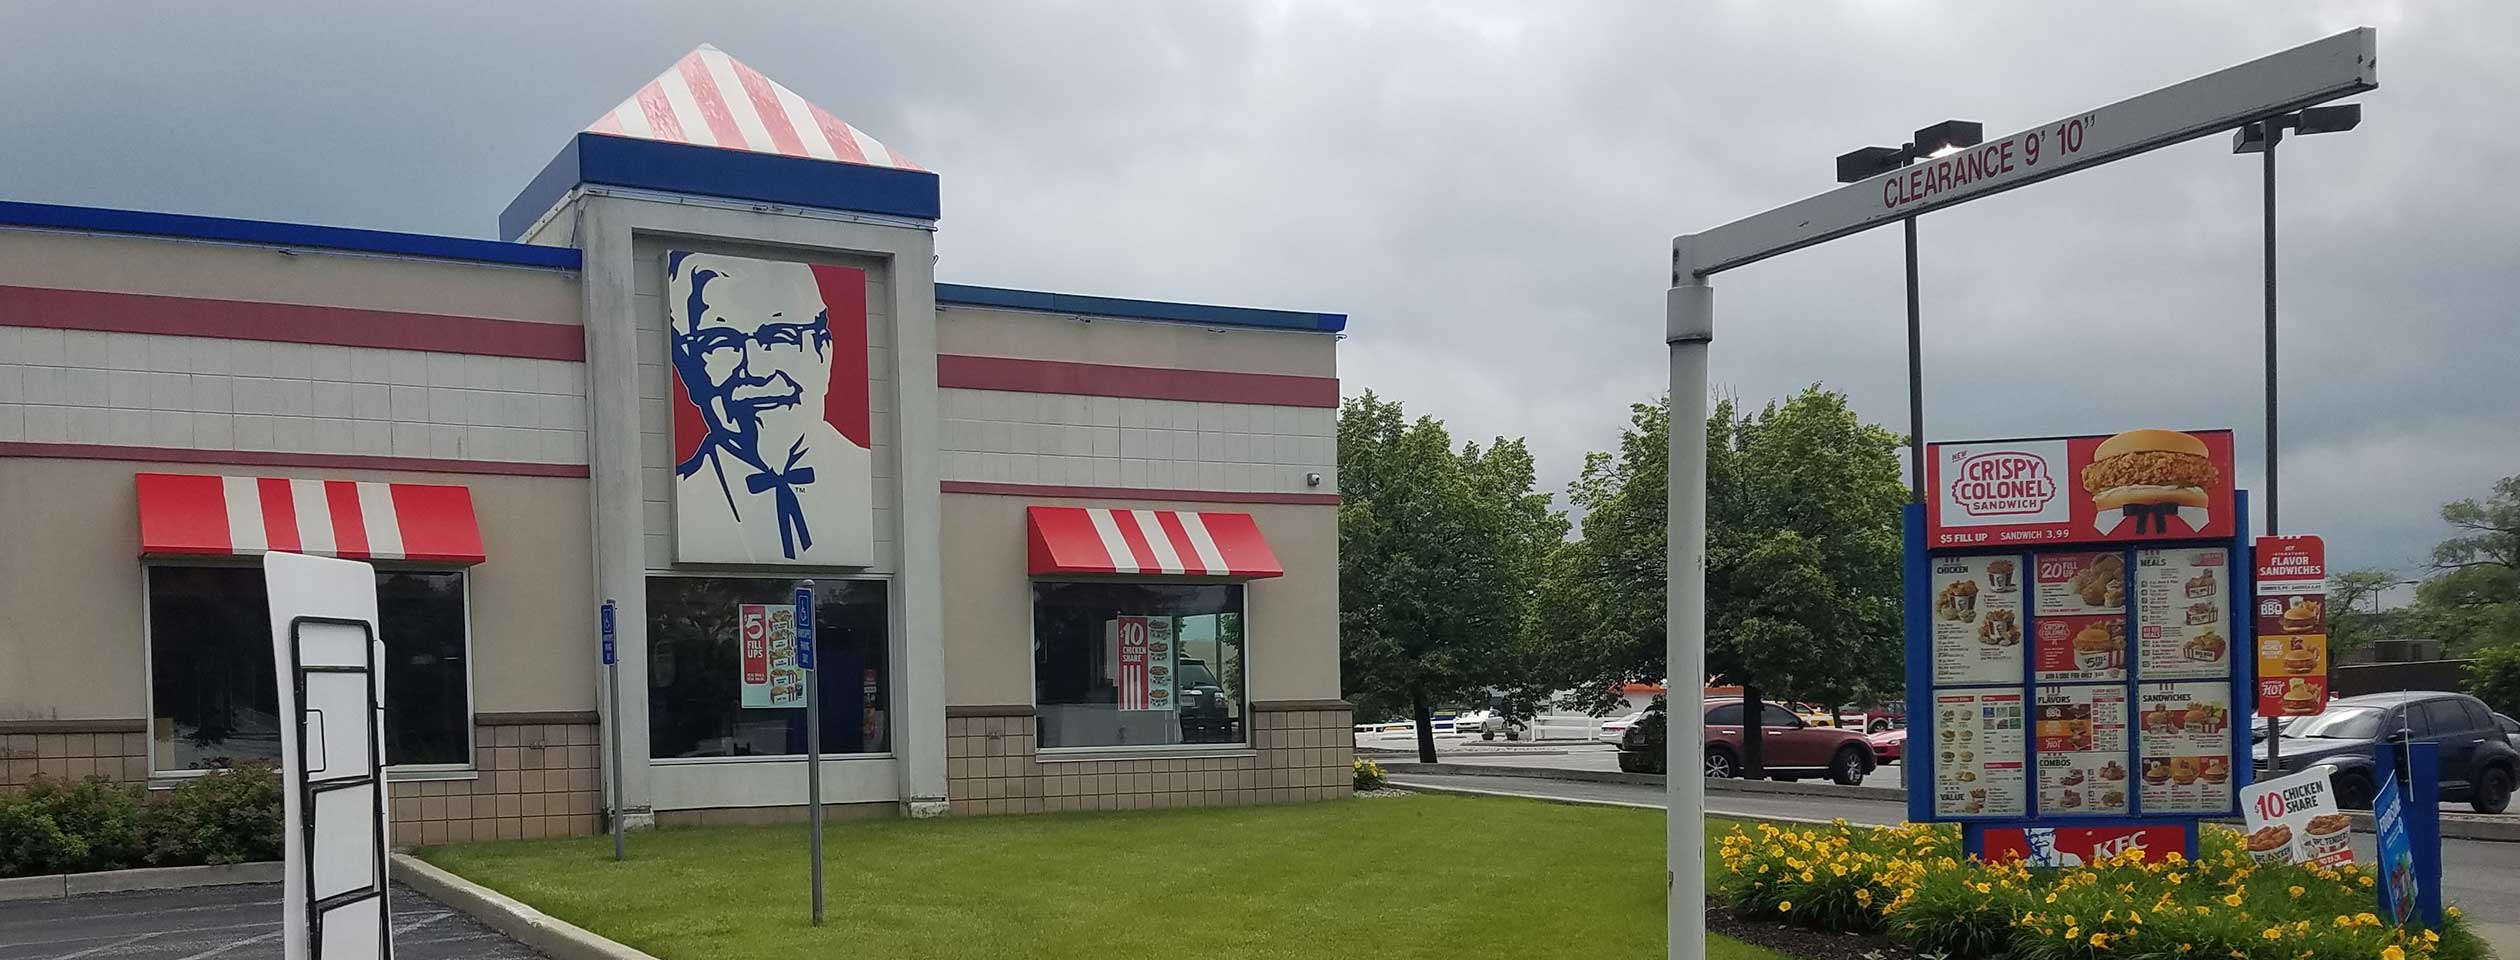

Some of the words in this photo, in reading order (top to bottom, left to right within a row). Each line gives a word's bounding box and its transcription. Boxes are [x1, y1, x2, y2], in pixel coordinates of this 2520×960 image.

[1884, 140, 2014, 208] CLEARANCE
[2025, 130, 2046, 166] 9'
[1969, 458, 2040, 481] CRISPY
[1961, 480, 2047, 500] COLONEL
[1973, 499, 2037, 510] SANDWICH
[1940, 533, 1953, 544] $5
[1954, 533, 1973, 543] FILL
[1975, 532, 1988, 541] UP
[2000, 530, 2042, 541] SANDWICH
[2047, 529, 2070, 539] 3.99
[2271, 556, 2309, 566] FLAVOR
[2063, 570, 2074, 578] UP
[2260, 565, 2321, 576] SANDWICHES
[2261, 602, 2283, 616] BBQ
[747, 640, 763, 650] FILL
[747, 649, 763, 659] UPS
[2262, 683, 2284, 696] HOT
[2038, 695, 2071, 704] FLAVORS
[2143, 694, 2192, 702] SANDWICHES
[2040, 759, 2071, 767] COMBOS
[2283, 780, 2324, 801] CHICKEN
[1940, 793, 1965, 801] VALUE
[2255, 792, 2285, 820] $10
[2286, 795, 2319, 814] SHARE
[2093, 831, 2150, 860] KFC
